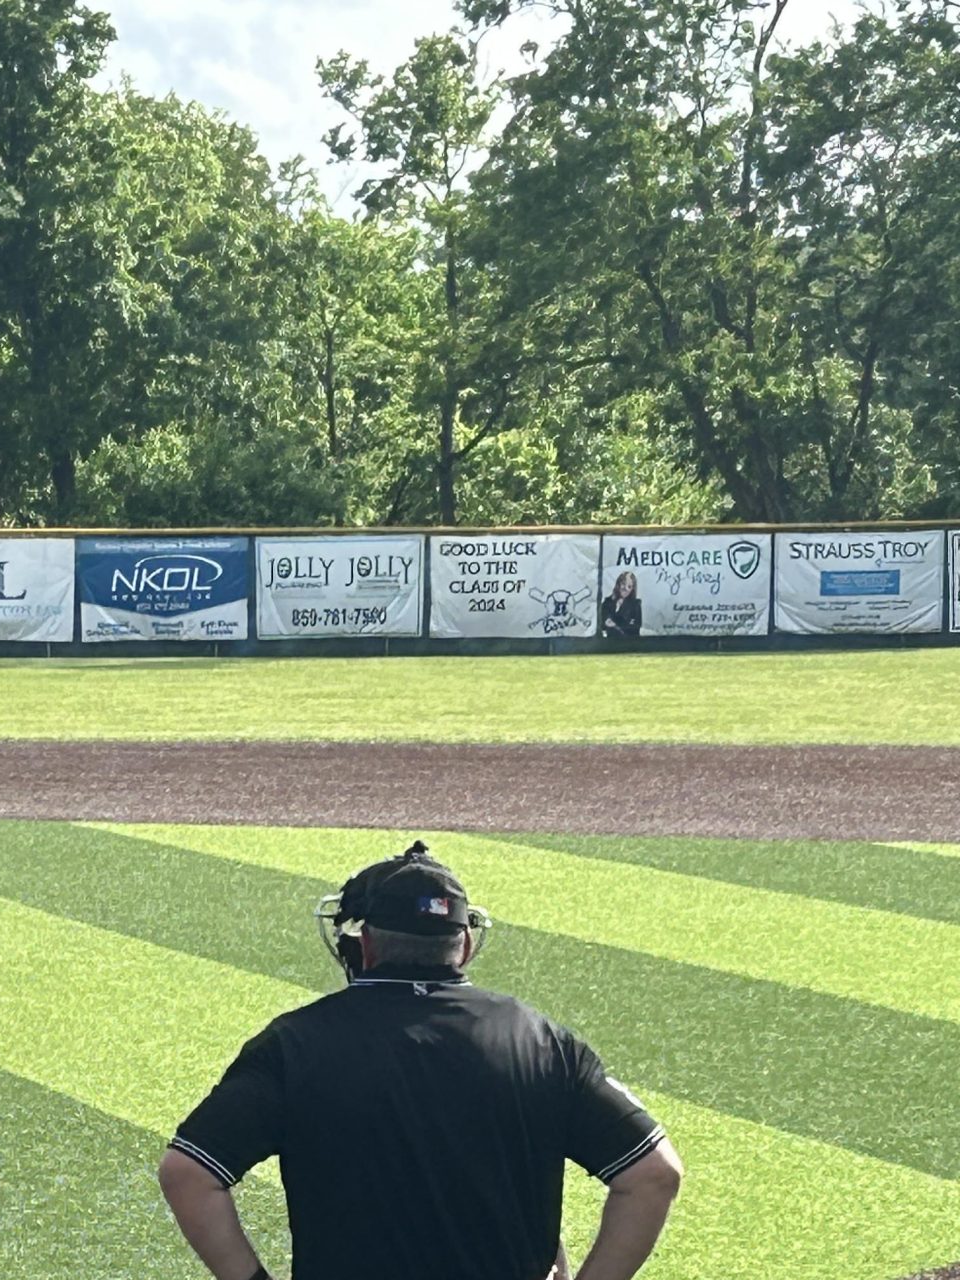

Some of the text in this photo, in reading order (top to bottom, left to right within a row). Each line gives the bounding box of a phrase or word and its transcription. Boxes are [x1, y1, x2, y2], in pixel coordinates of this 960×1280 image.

[440, 542, 537, 556] GOOD LUCK
[616, 547, 723, 566] MEDICARE
[790, 540, 928, 559] STRAUSS TROY
[265, 556, 335, 588] JOLLY
[345, 555, 414, 586] JOLLY
[458, 561, 518, 575] TO THE
[111, 567, 212, 592] NKOL
[449, 579, 526, 594] CLASS OF
[468, 598, 506, 612] 2024
